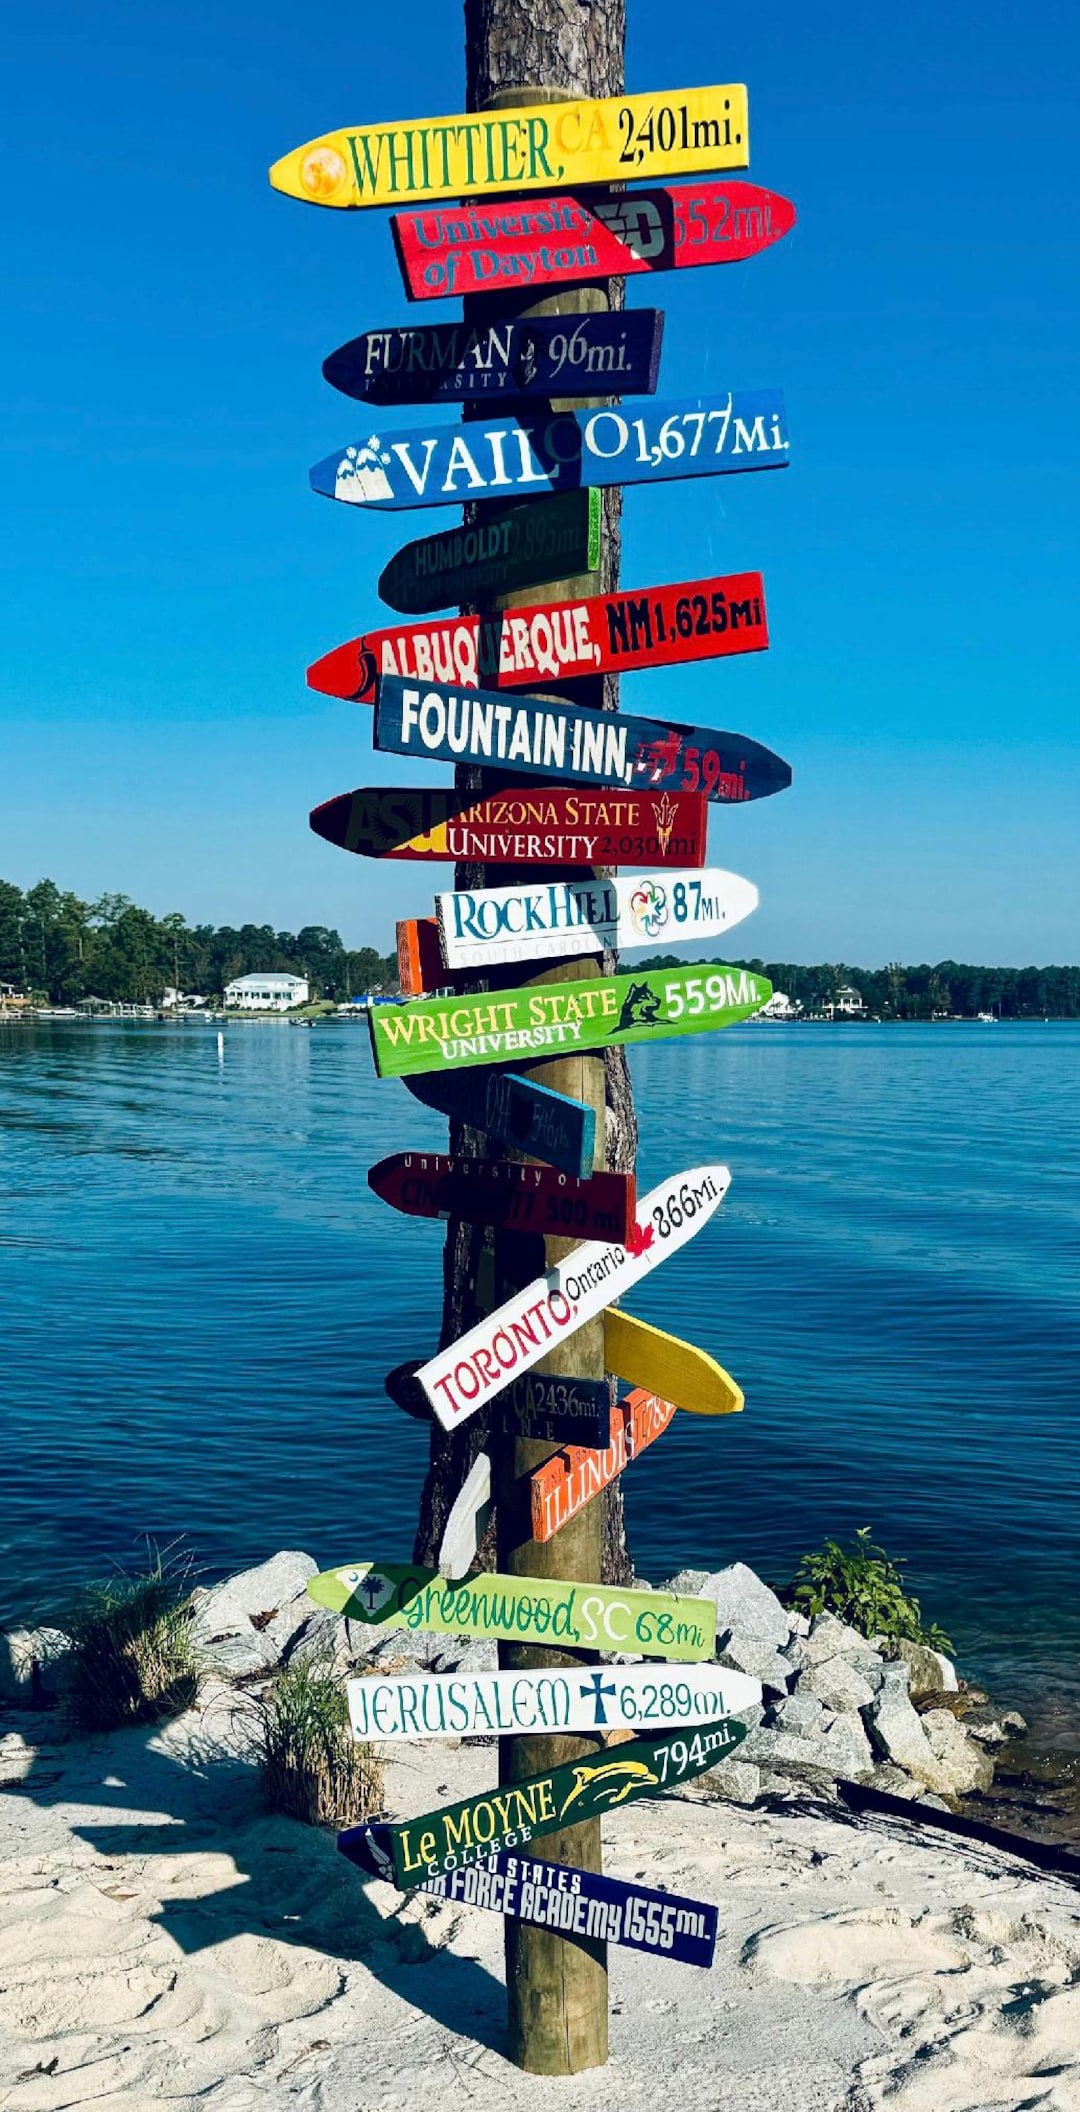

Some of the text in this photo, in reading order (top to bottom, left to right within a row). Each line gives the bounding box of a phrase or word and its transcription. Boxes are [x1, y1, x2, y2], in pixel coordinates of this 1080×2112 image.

[346, 98, 742, 196] WHITTIER, CA 2,401mi.
[411, 199, 594, 248] University
[423, 244, 597, 296] of Dayton
[364, 317, 632, 384] FURMAN 96mi.
[390, 428, 560, 495] VAIL
[414, 520, 512, 577] HUMBOLDT
[379, 604, 602, 687] ALBUQUERQUE,
[605, 597, 653, 654] NM
[401, 688, 750, 800] FOUNTAIN INN, 59mi.
[447, 798, 560, 828] ARIZONA
[564, 796, 640, 827] STATE
[448, 828, 598, 860] UNIVERSITY
[459, 935, 624, 967] SOUTH CAROLINA
[377, 1003, 518, 1047] WRIGHT
[529, 987, 619, 1025] STATE
[441, 1021, 583, 1061] UNIVERSITY
[403, 1154, 544, 1187] University
[433, 1288, 579, 1414] TORONTO,
[565, 1245, 625, 1301] Ontario
[535, 1382, 600, 1420] 2436mi.
[545, 1421, 636, 1536] ILLINOIS
[581, 1596, 632, 1642] SC
[635, 1610, 705, 1650] 68mi
[355, 1677, 571, 1736] JERUSALEM
[399, 1720, 737, 1873] Le MOYNE 794mi.
[426, 1826, 534, 1878] COLLEGE
[505, 1857, 582, 1896] STATES
[450, 1866, 520, 1916] FORCE
[519, 1881, 623, 1943] ACADEMY
